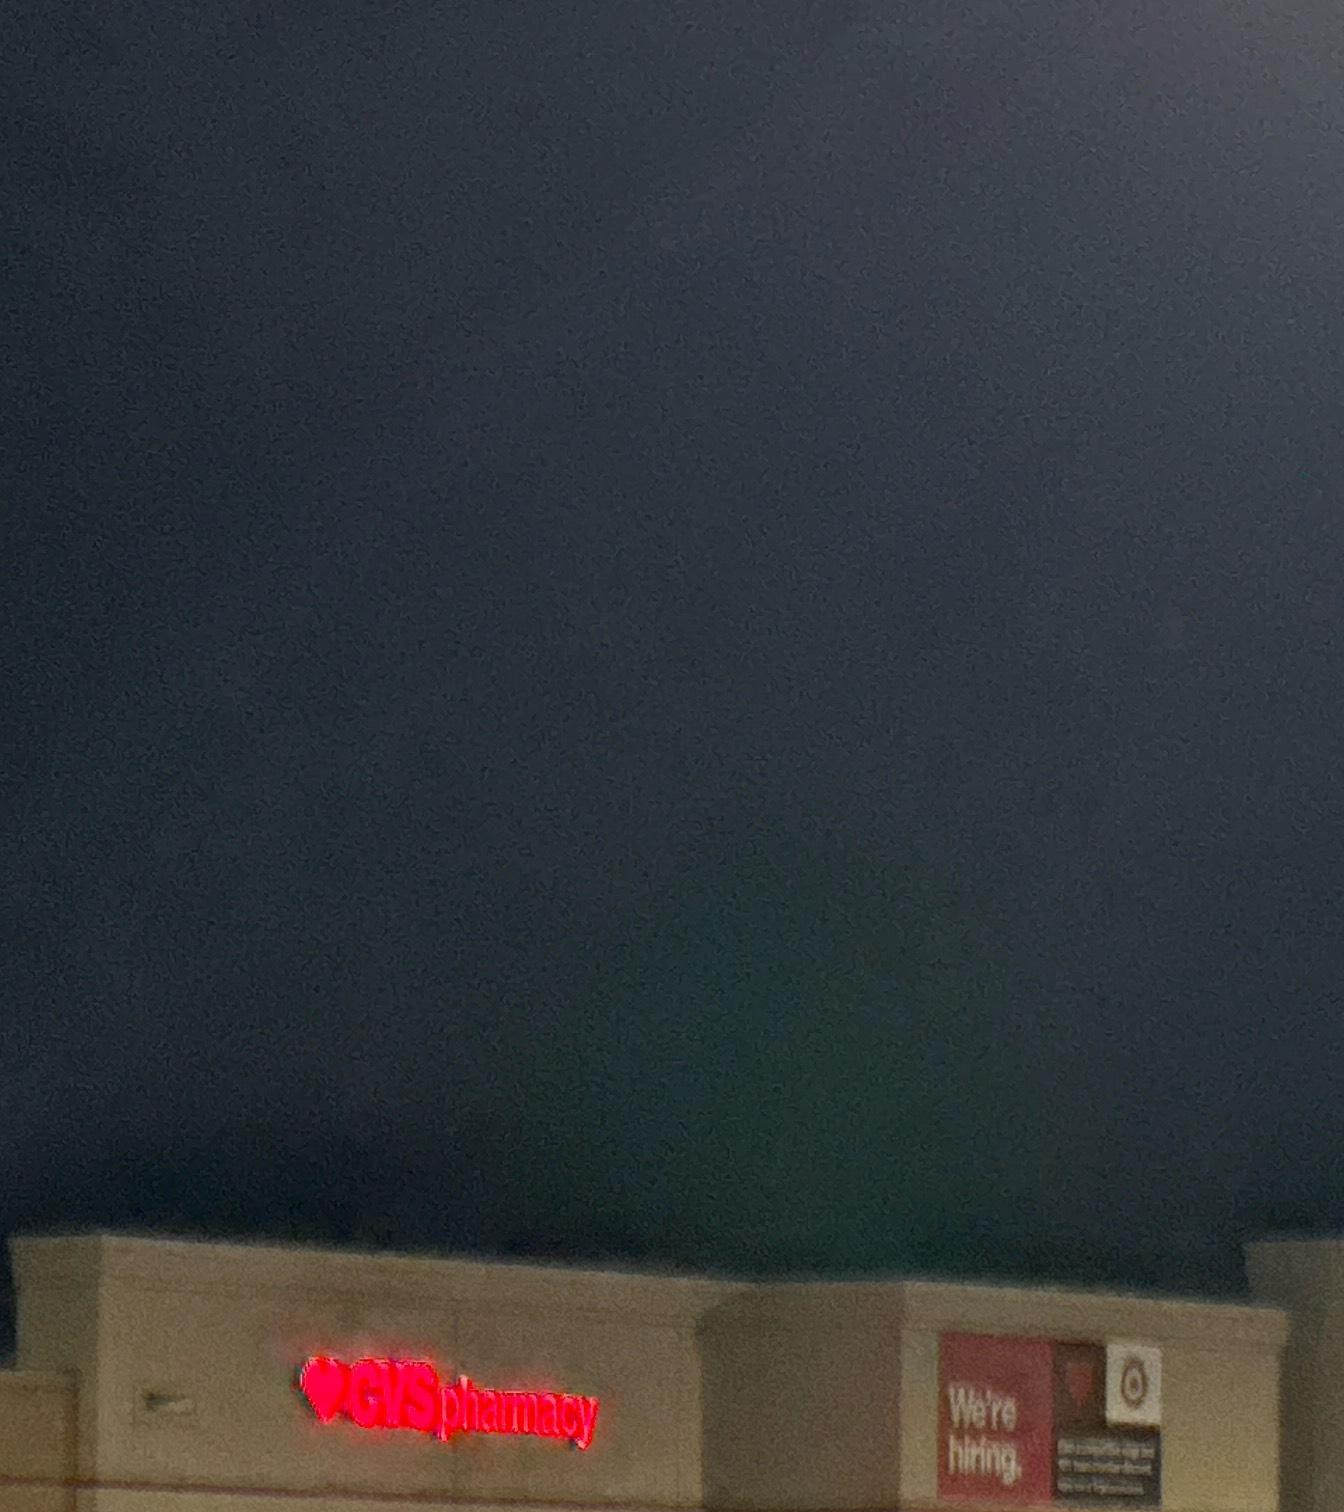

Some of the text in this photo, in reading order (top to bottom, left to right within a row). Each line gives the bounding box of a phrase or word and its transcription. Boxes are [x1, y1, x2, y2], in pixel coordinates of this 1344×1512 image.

[350, 1357, 599, 1450] CVS pharmacy
[949, 1385, 1017, 1432] We're
